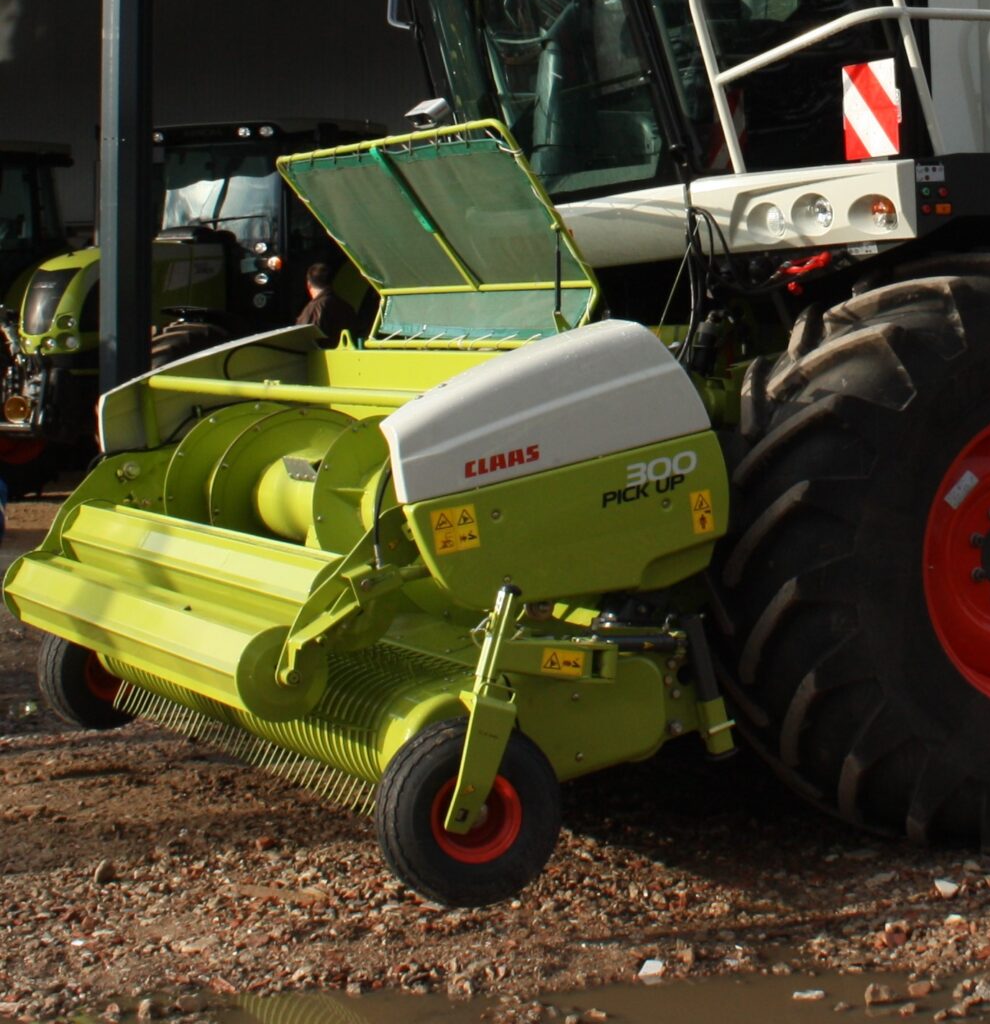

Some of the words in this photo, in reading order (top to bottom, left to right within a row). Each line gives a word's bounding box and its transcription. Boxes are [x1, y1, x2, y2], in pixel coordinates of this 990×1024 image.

[464, 444, 540, 478] CLAAS
[626, 451, 697, 487] 300
[602, 480, 649, 508] PICK
[656, 473, 684, 493] UP
